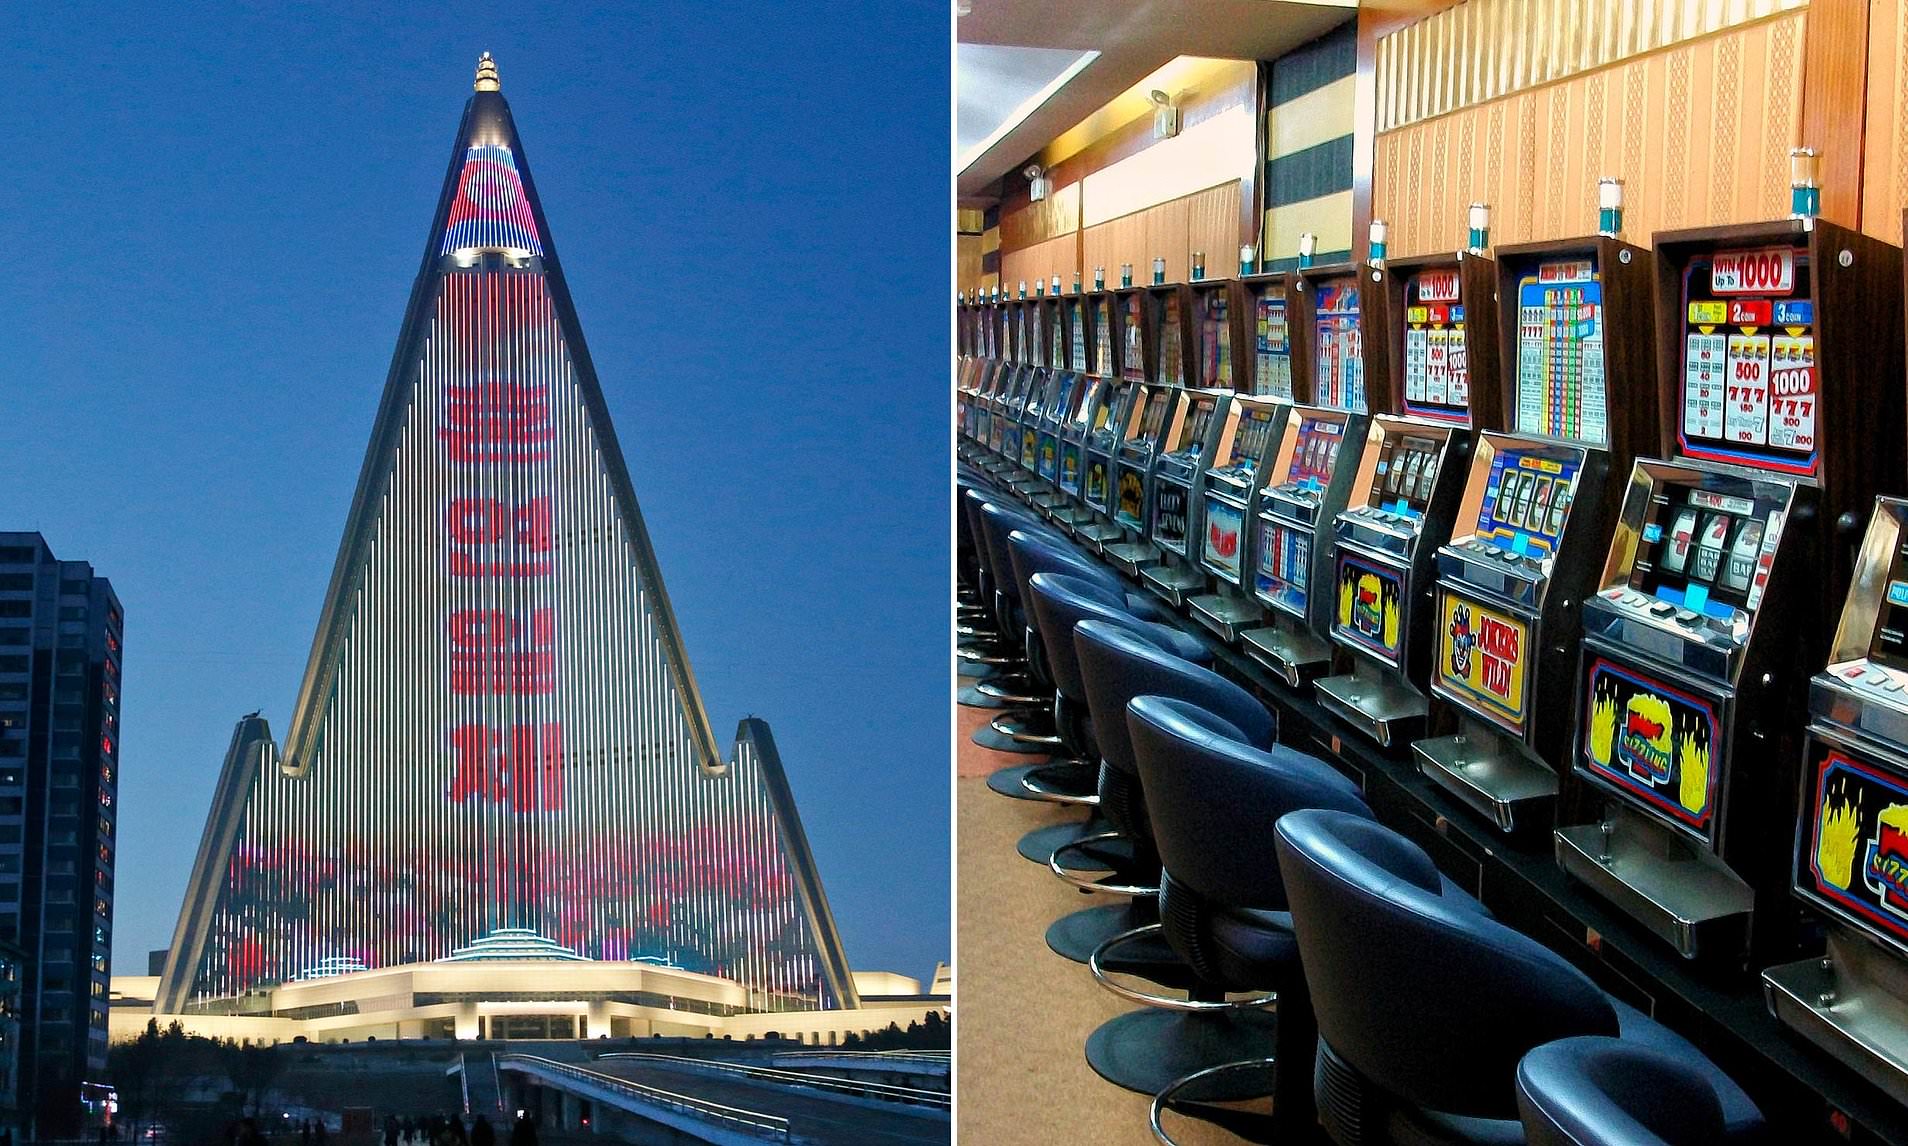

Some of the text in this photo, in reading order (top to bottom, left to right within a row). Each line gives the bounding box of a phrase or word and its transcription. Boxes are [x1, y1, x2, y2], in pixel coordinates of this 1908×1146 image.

[1714, 257, 1736, 273] WIN
[1737, 254, 1782, 288] 1000
[1431, 273, 1454, 298] 1000
[1715, 275, 1735, 288] Up To
[1732, 303, 1741, 323] 2
[1778, 303, 1786, 323] 3
[1735, 362, 1760, 381] 500
[1772, 369, 1810, 395] 1000
[1739, 432, 1752, 440] 100
